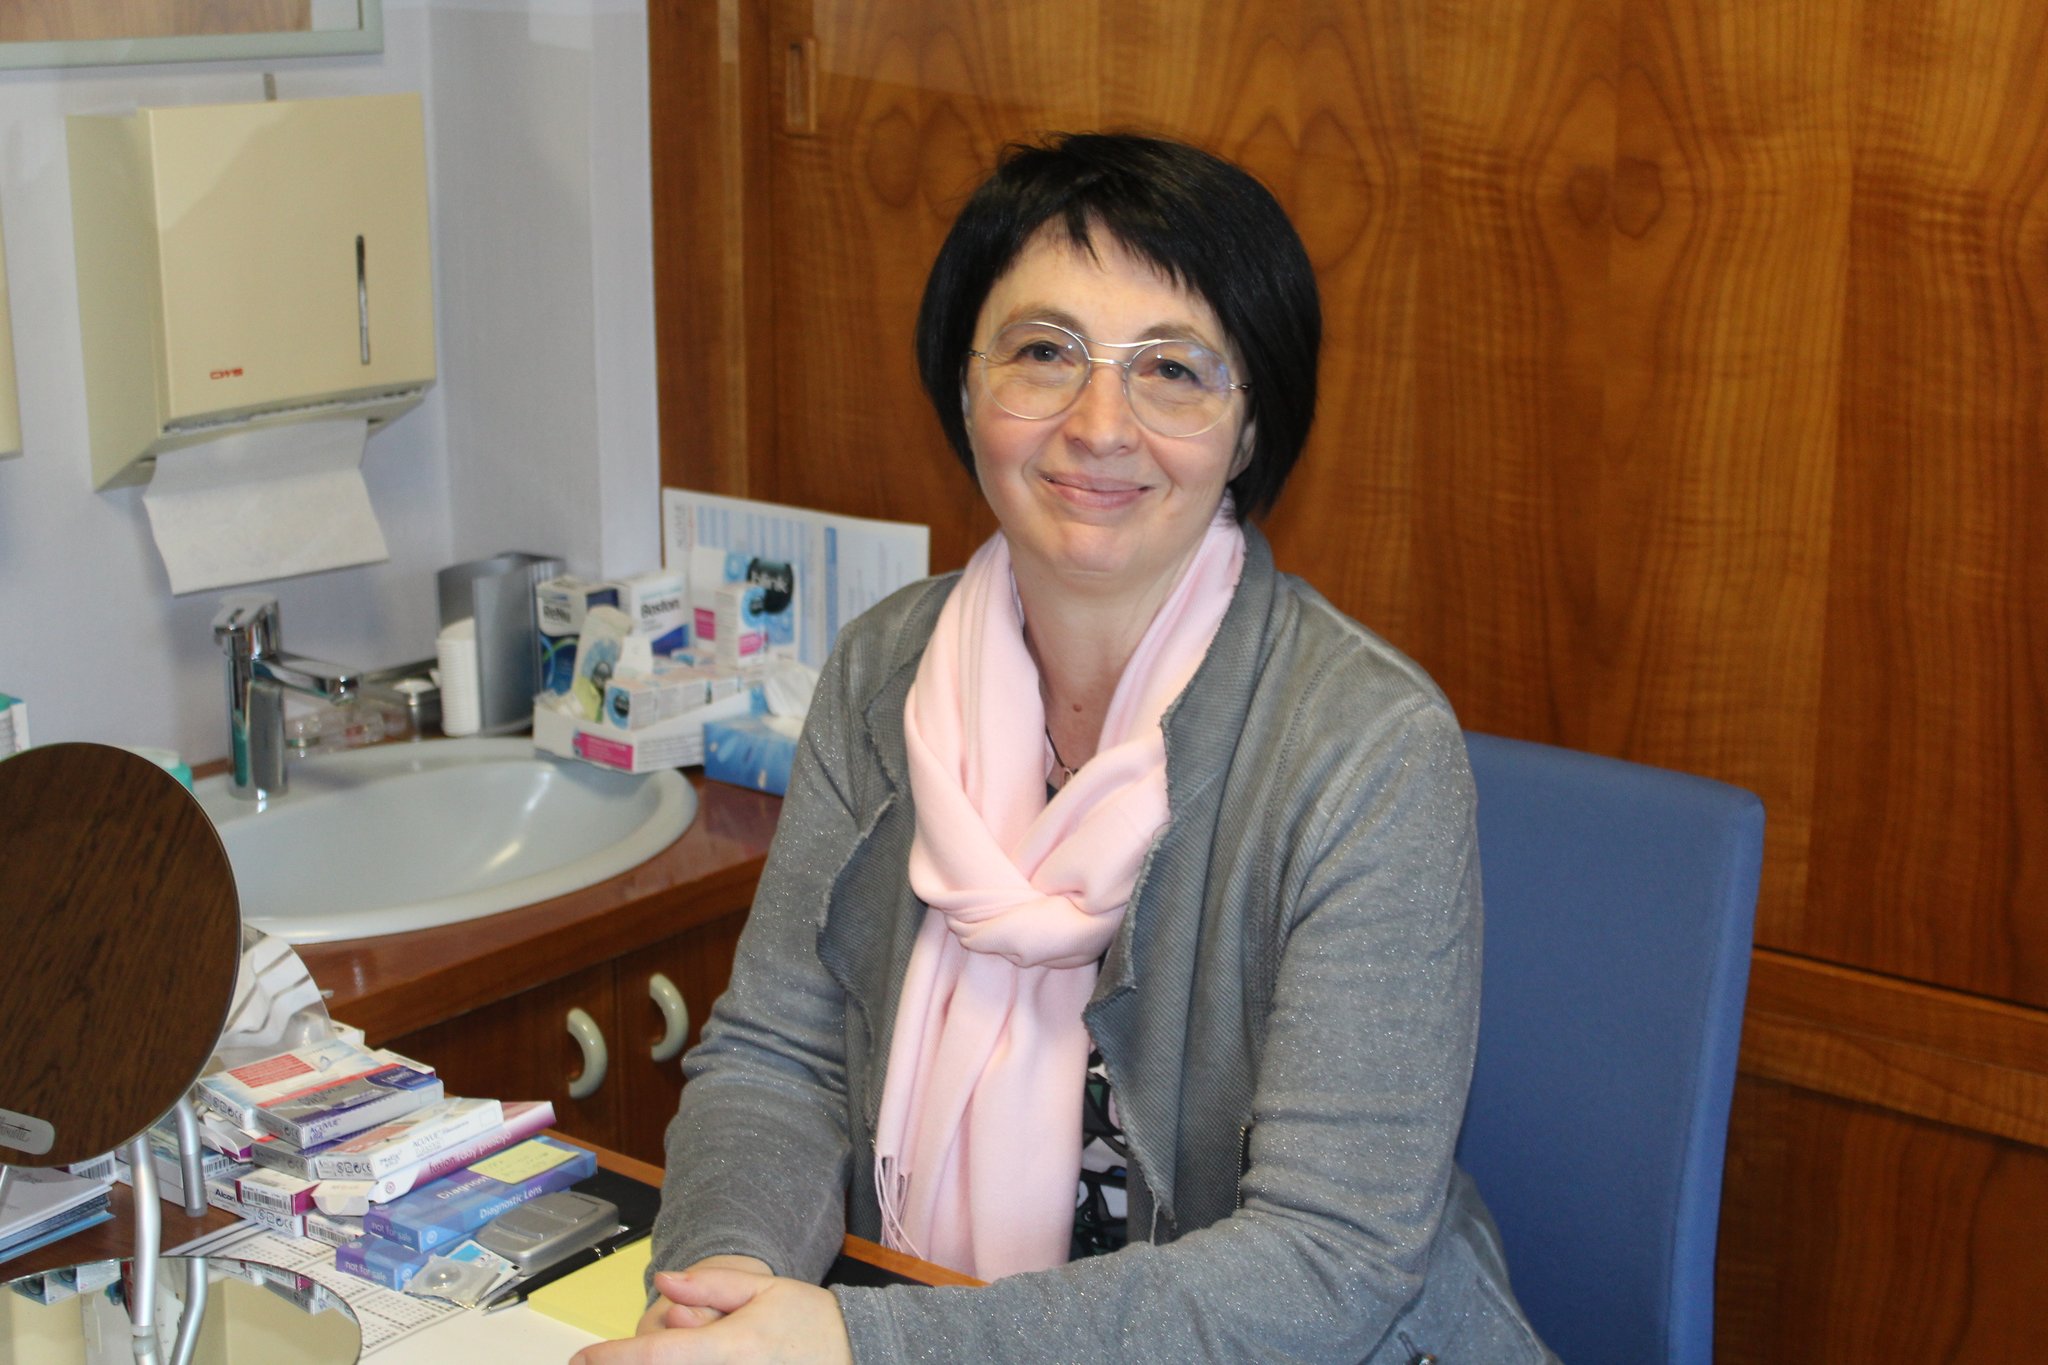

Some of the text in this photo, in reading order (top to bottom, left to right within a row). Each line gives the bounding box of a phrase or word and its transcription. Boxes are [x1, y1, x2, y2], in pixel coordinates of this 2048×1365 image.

[641, 599, 680, 618] Boston
[215, 1188, 236, 1201] Alcon
[480, 1184, 543, 1219] Diagnostic Lens
[371, 1222, 384, 1233] not
[345, 1260, 357, 1272] not
